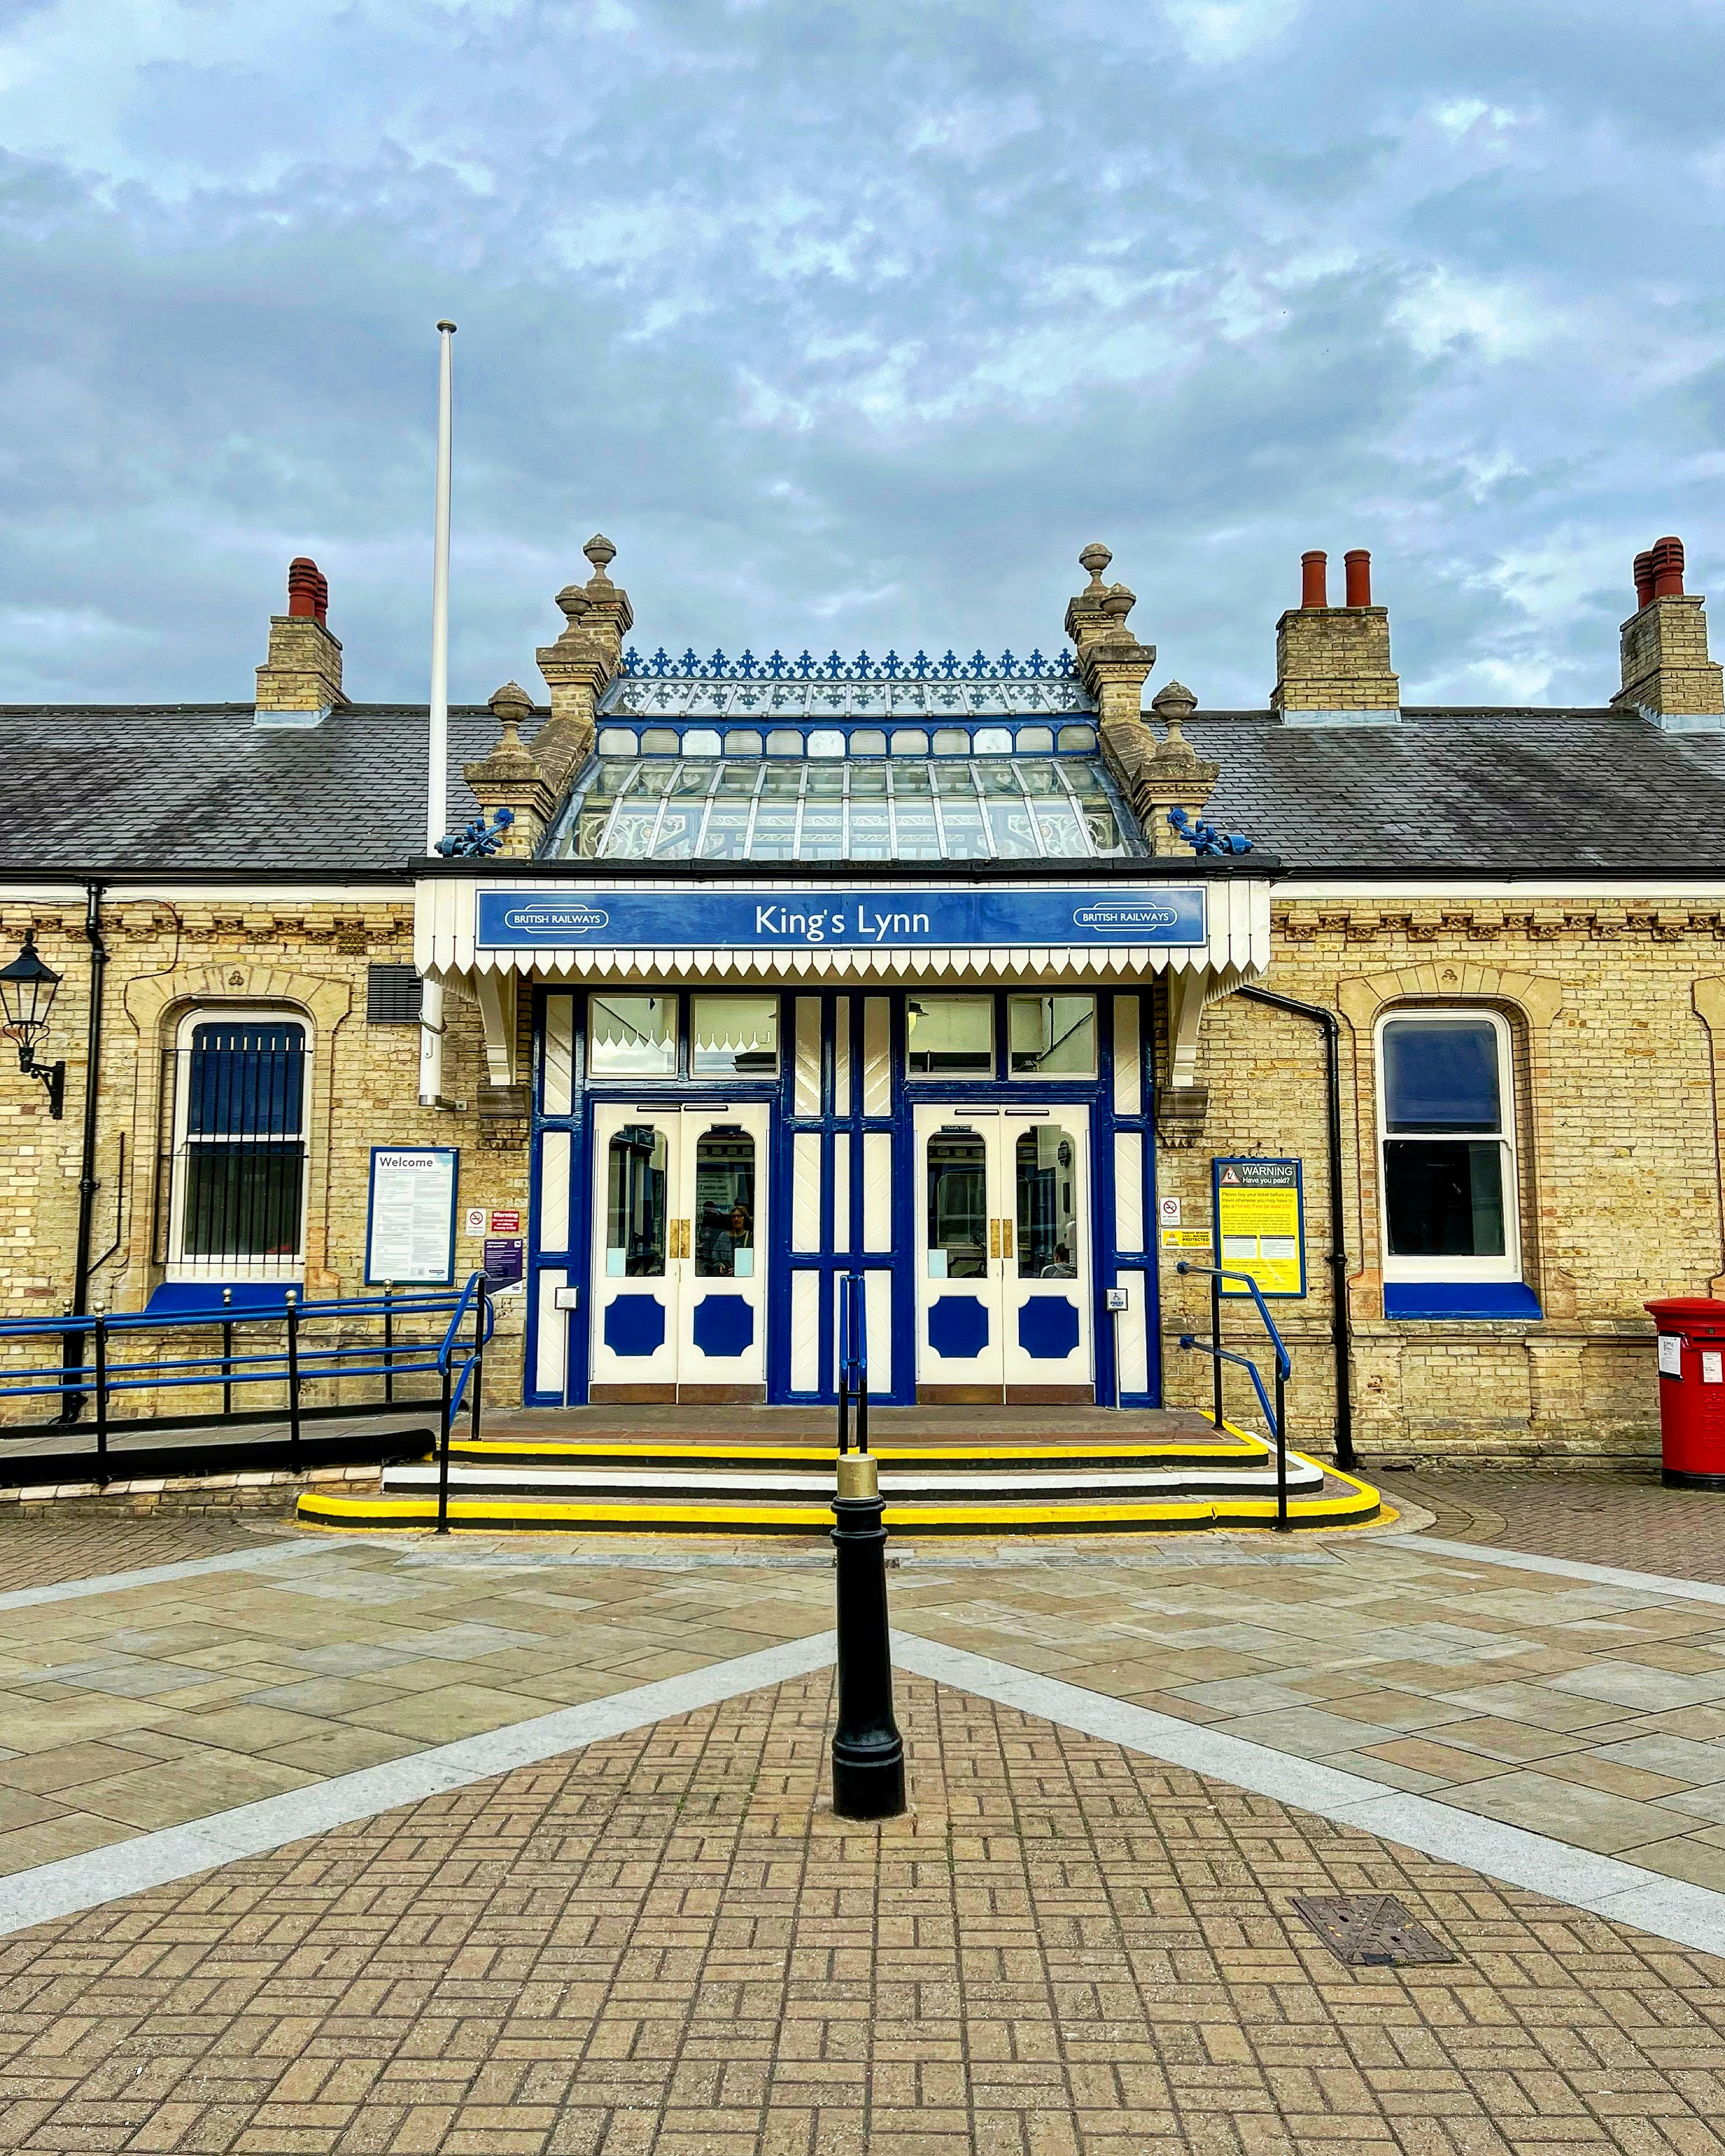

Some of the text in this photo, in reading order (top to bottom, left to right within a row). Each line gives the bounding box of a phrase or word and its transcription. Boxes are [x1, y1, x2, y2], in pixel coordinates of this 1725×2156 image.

[514, 915, 600, 923] BRITISH RAILWAYS
[1083, 912, 1169, 922] BRITISH RAILWAYS
[756, 905, 930, 941] King's Lynn
[380, 1156, 433, 1167] Welcome
[1242, 1166, 1293, 1176] WARNING
